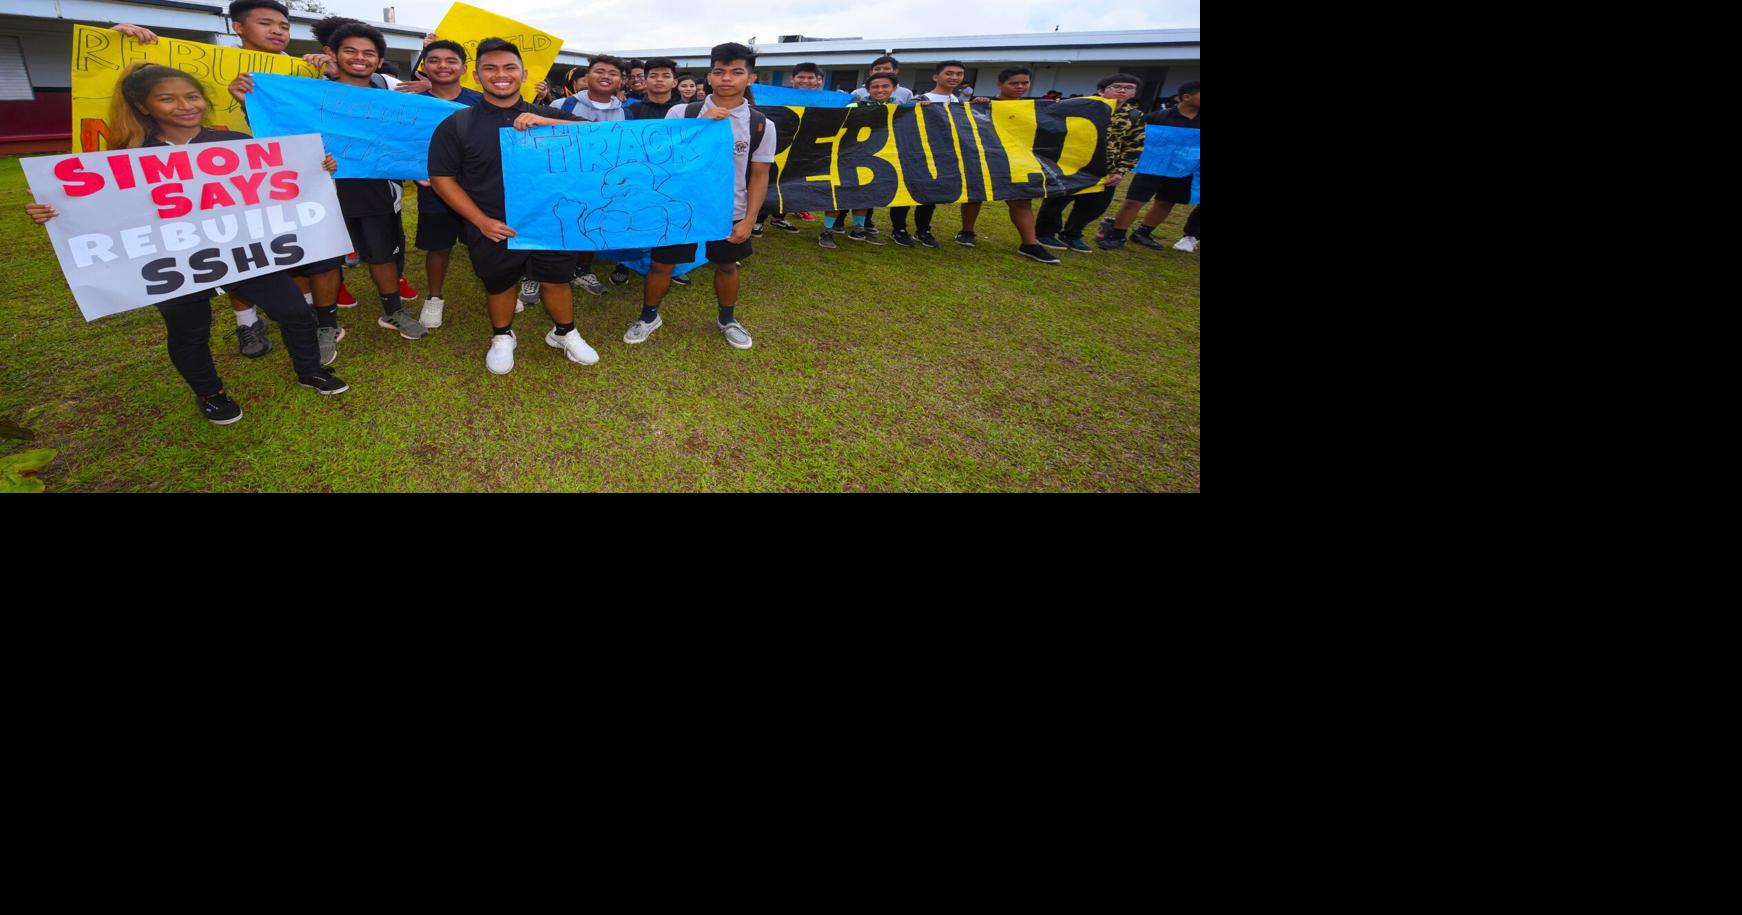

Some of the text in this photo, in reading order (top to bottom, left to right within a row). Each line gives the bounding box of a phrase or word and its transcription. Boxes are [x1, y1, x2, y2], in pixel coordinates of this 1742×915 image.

[54, 142, 284, 197] SIMON
[534, 122, 701, 173] TRACK
[152, 171, 300, 219] SAYS
[68, 201, 326, 268] REBUILD
[141, 234, 305, 295] SSHS
